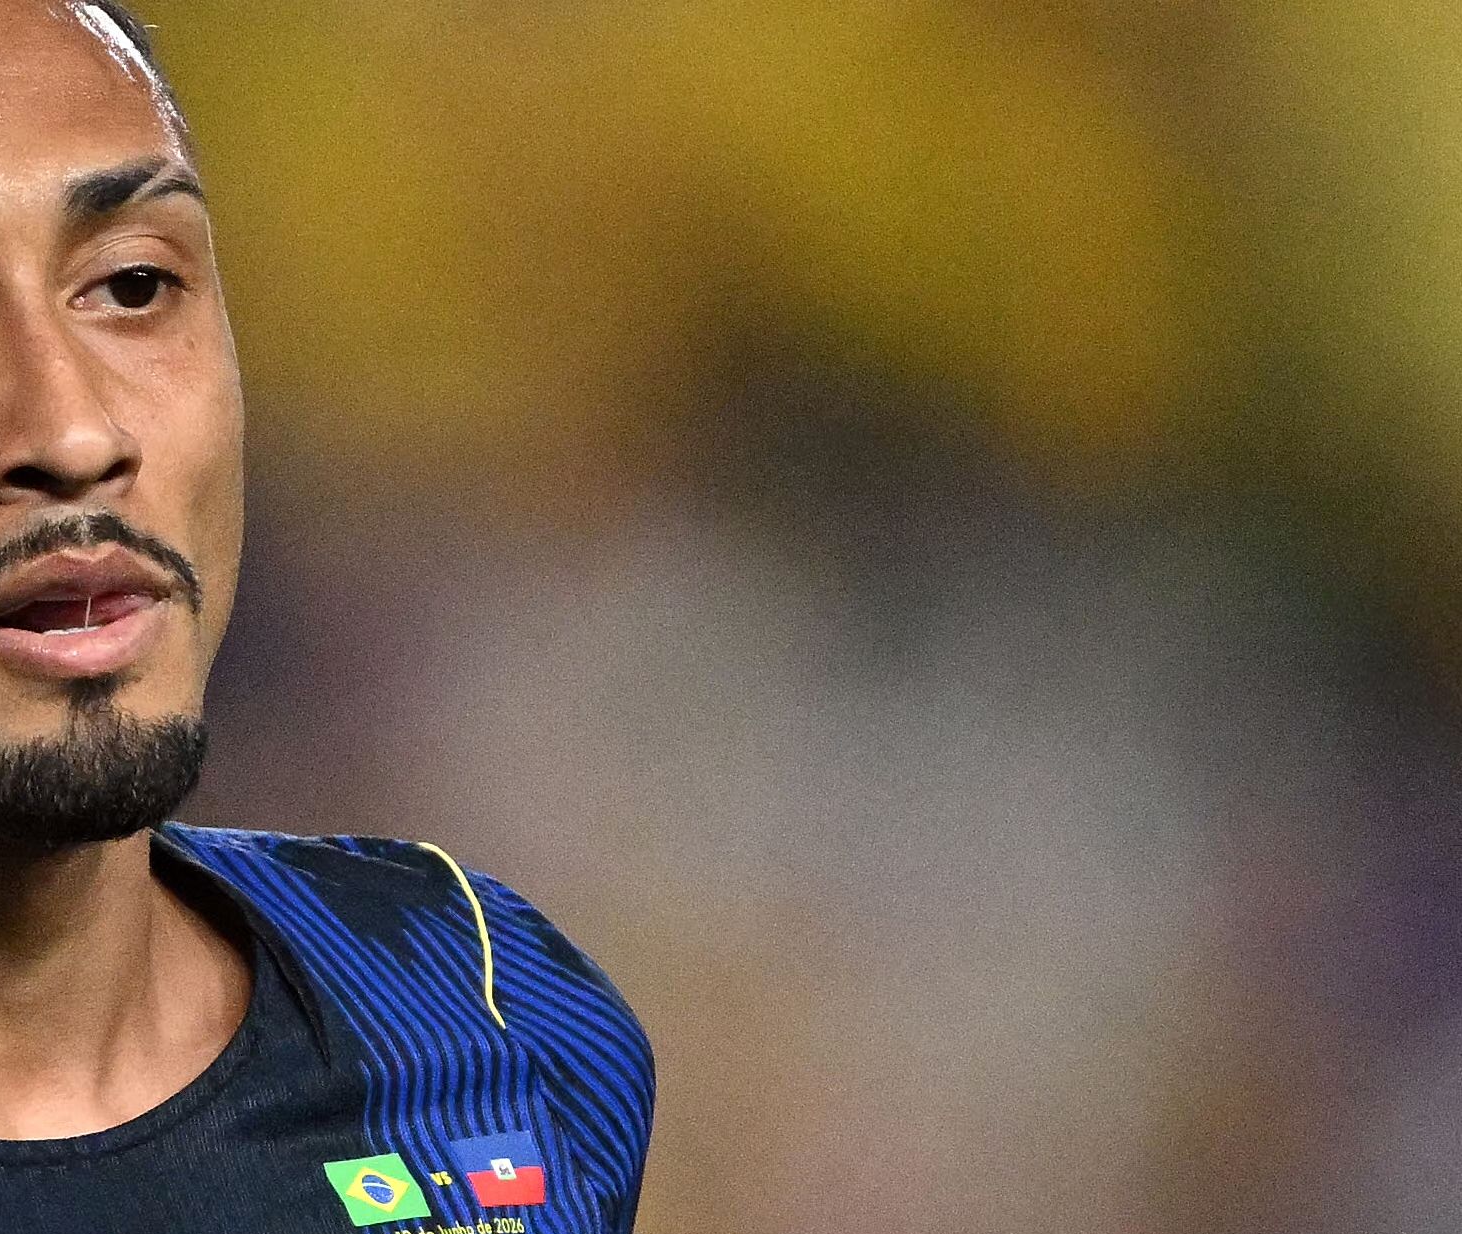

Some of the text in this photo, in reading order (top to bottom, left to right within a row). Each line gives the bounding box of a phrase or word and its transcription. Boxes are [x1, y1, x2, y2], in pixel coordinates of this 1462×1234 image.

[429, 1170, 453, 1186] vs
[477, 1218, 492, 1234] de
[494, 1217, 525, 1234] 2026
